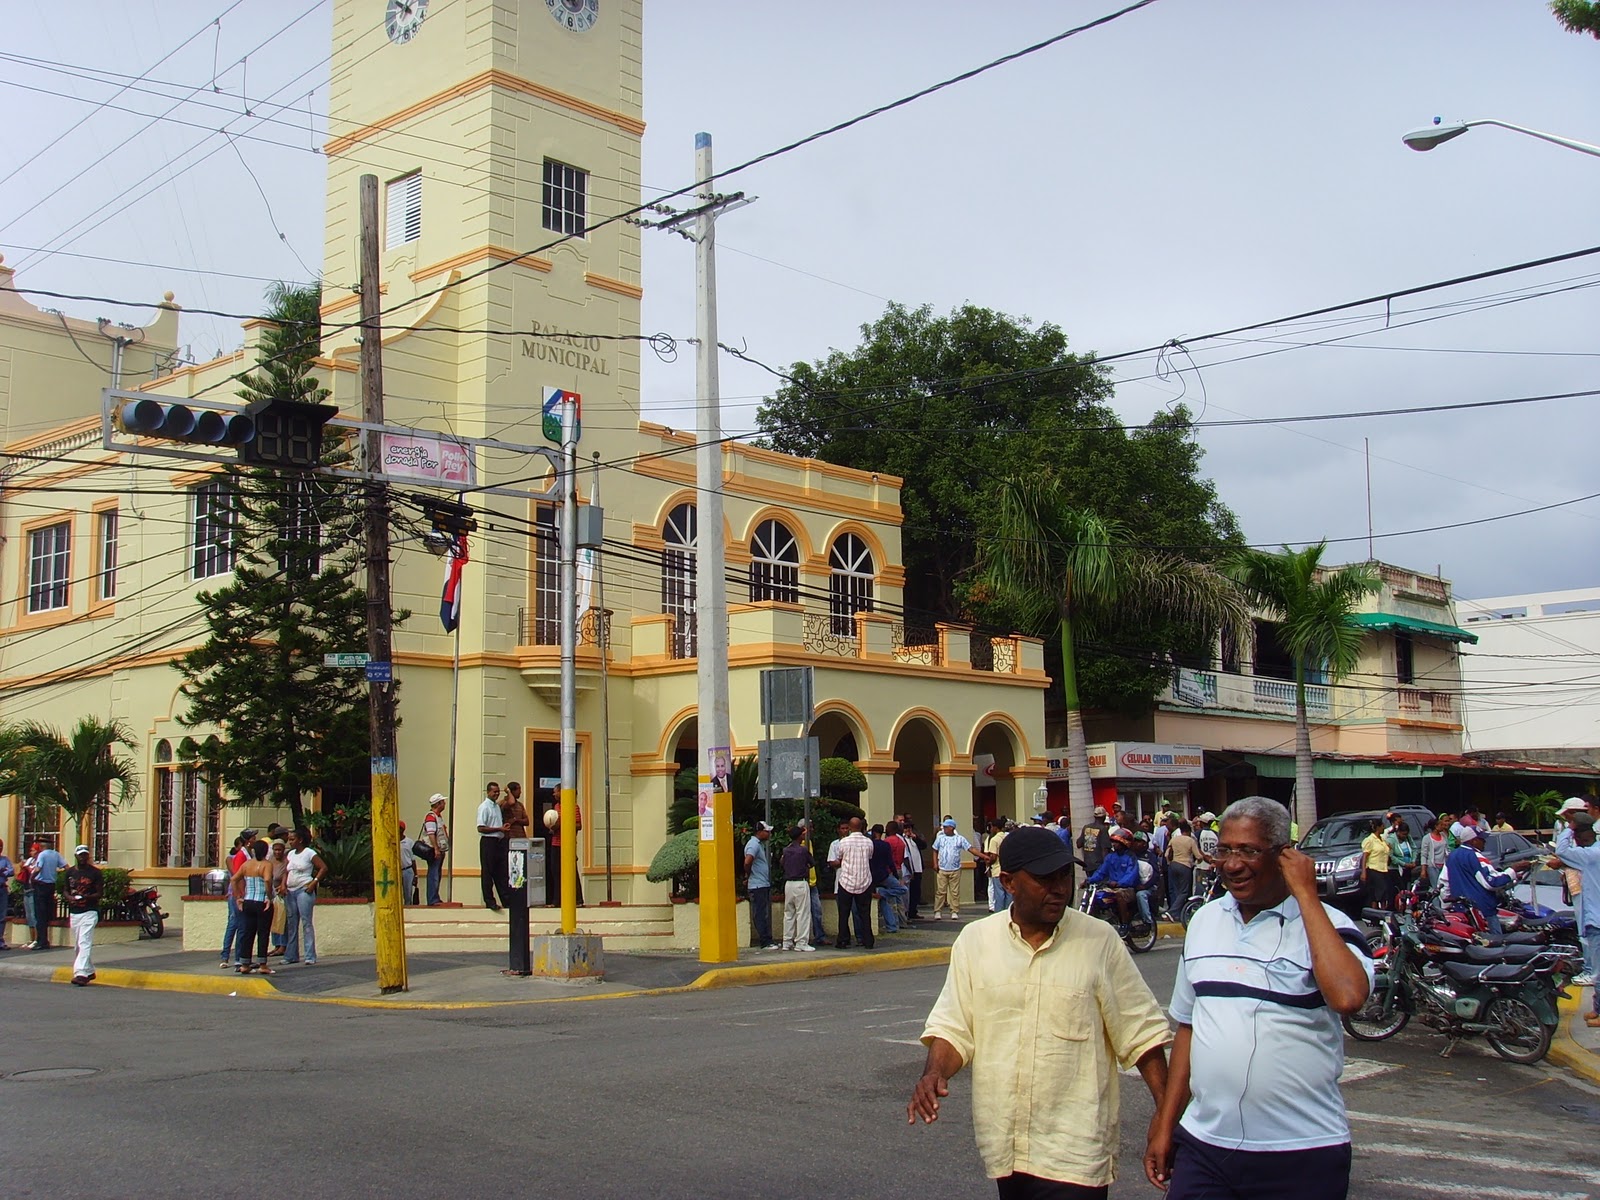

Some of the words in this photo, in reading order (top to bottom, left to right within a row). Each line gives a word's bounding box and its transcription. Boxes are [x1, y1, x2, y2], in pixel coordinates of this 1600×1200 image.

[567, 16, 574, 27] 6
[531, 319, 601, 352] PALACIO
[521, 339, 611, 376] MUNICIPAL
[385, 454, 418, 467] donada
[442, 450, 466, 462] Pollo
[444, 459, 463, 471] Rey
[1127, 753, 1152, 764] CELULAR
[1152, 754, 1173, 764] CENTER
[1173, 755, 1201, 765] BOUTIQUE
